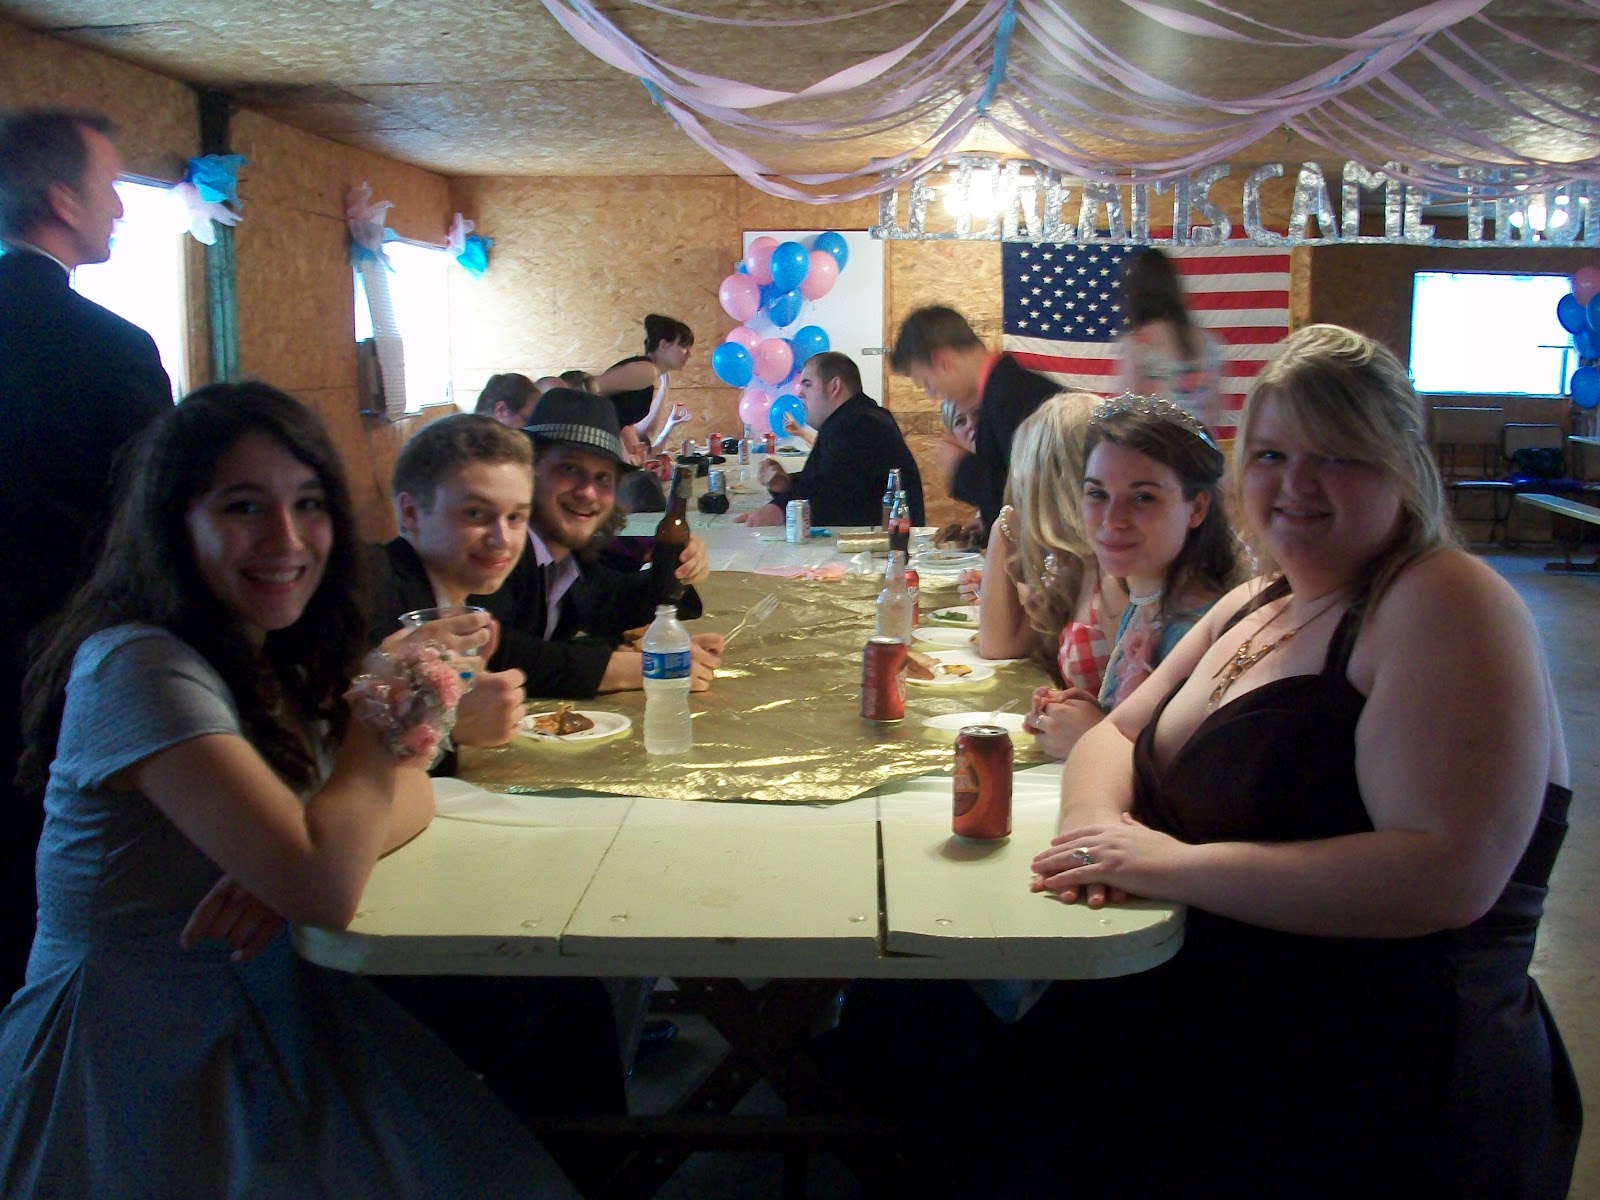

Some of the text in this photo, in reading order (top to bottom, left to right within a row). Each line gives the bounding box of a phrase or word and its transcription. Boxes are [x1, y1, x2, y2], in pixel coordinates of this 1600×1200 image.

[869, 156, 943, 240] IF
[952, 156, 1232, 246] DREAMS
[1243, 160, 1437, 247] CAME
